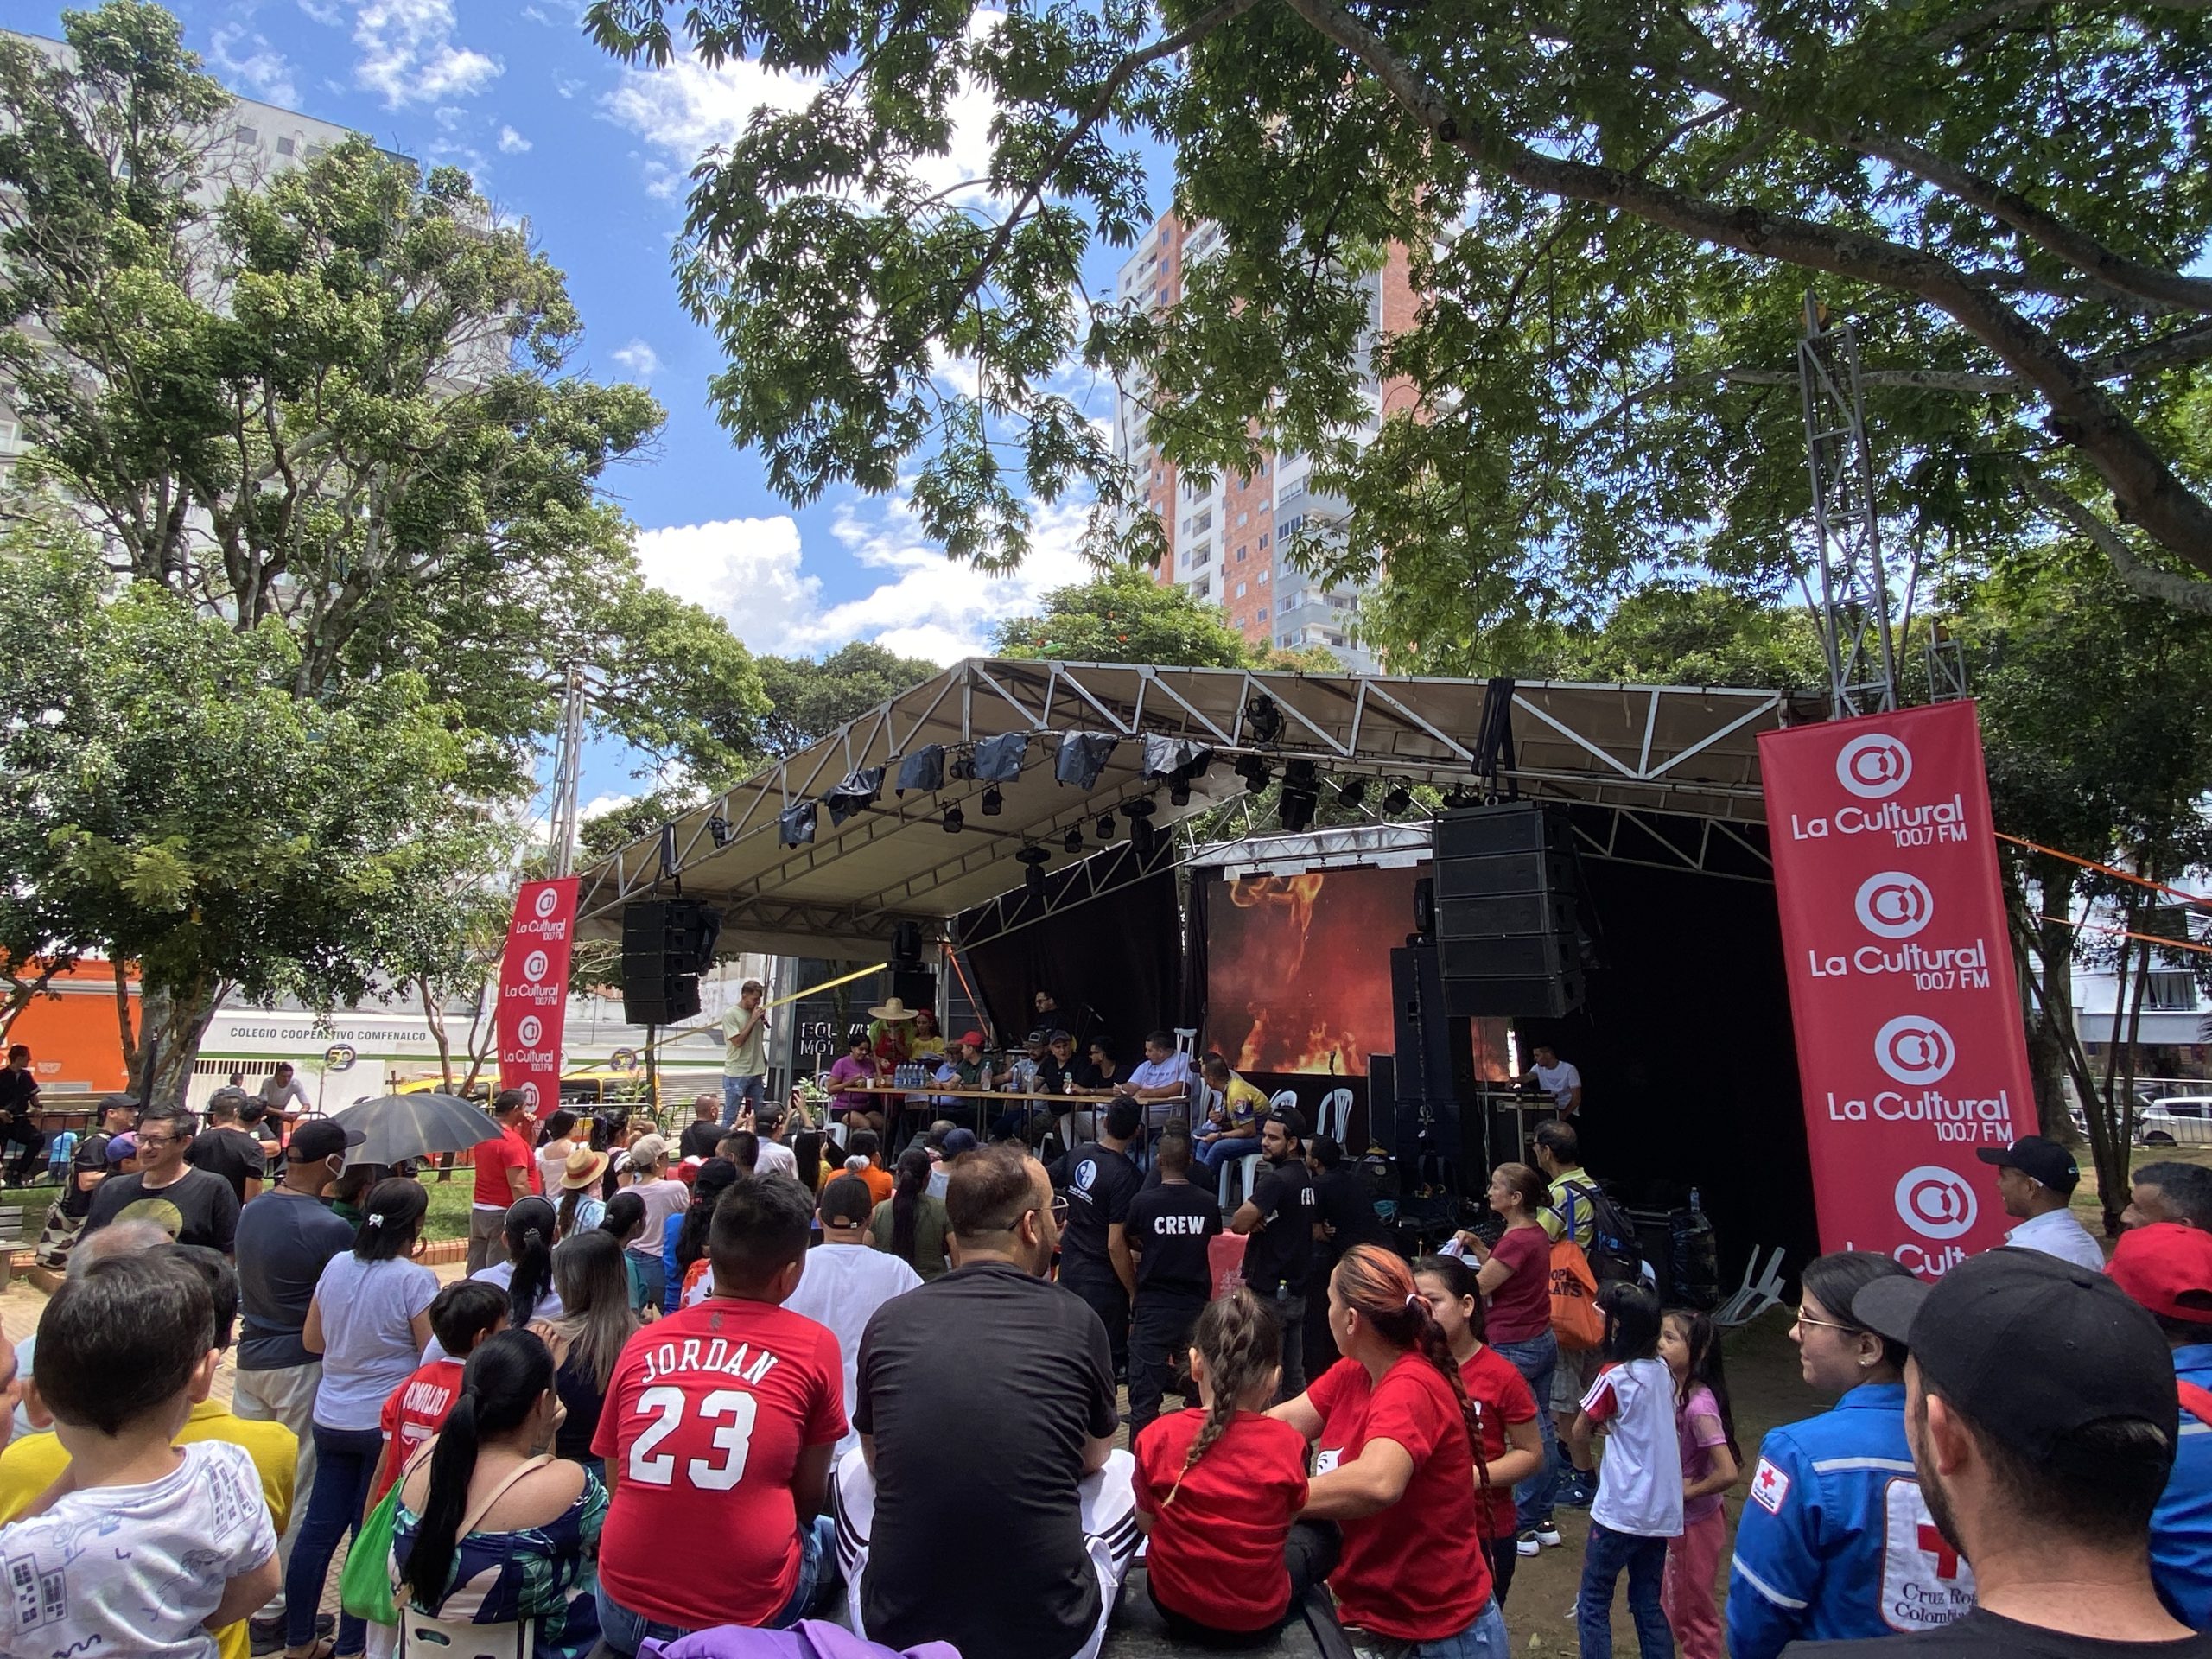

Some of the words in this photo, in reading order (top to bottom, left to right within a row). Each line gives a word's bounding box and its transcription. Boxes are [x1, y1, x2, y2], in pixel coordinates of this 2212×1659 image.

[1791, 814, 1828, 840] La
[1834, 793, 1964, 834] Cultural
[1892, 827, 1934, 848] 100.7
[1937, 823, 1967, 843] FM
[516, 921, 527, 933] La
[528, 918, 566, 933] Cultural
[1809, 950, 1847, 976] La
[1853, 938, 1986, 974] Cultural
[505, 984, 517, 997] La
[518, 982, 559, 996] Cultural
[1912, 970, 1955, 991] 100.7
[1959, 969, 1990, 988] FM
[230, 1027, 277, 1038] COLEGIO
[281, 1029, 354, 1039] COOPERTIVO
[357, 1031, 427, 1041] COMFENALCO
[504, 1049, 515, 1062] La
[515, 1049, 554, 1063] Cultural
[1827, 1092, 1866, 1120] La
[1873, 1090, 2010, 1120] Cultural
[1934, 1122, 1978, 1141] 100.7
[1981, 1122, 2013, 1141] FM
[1154, 1216, 1205, 1235] CREW
[1893, 1243, 1970, 1276] Cult
[641, 1338, 779, 1386] JORDAN
[628, 1386, 758, 1491] 23
[1902, 1582, 1945, 1605] Cruz
